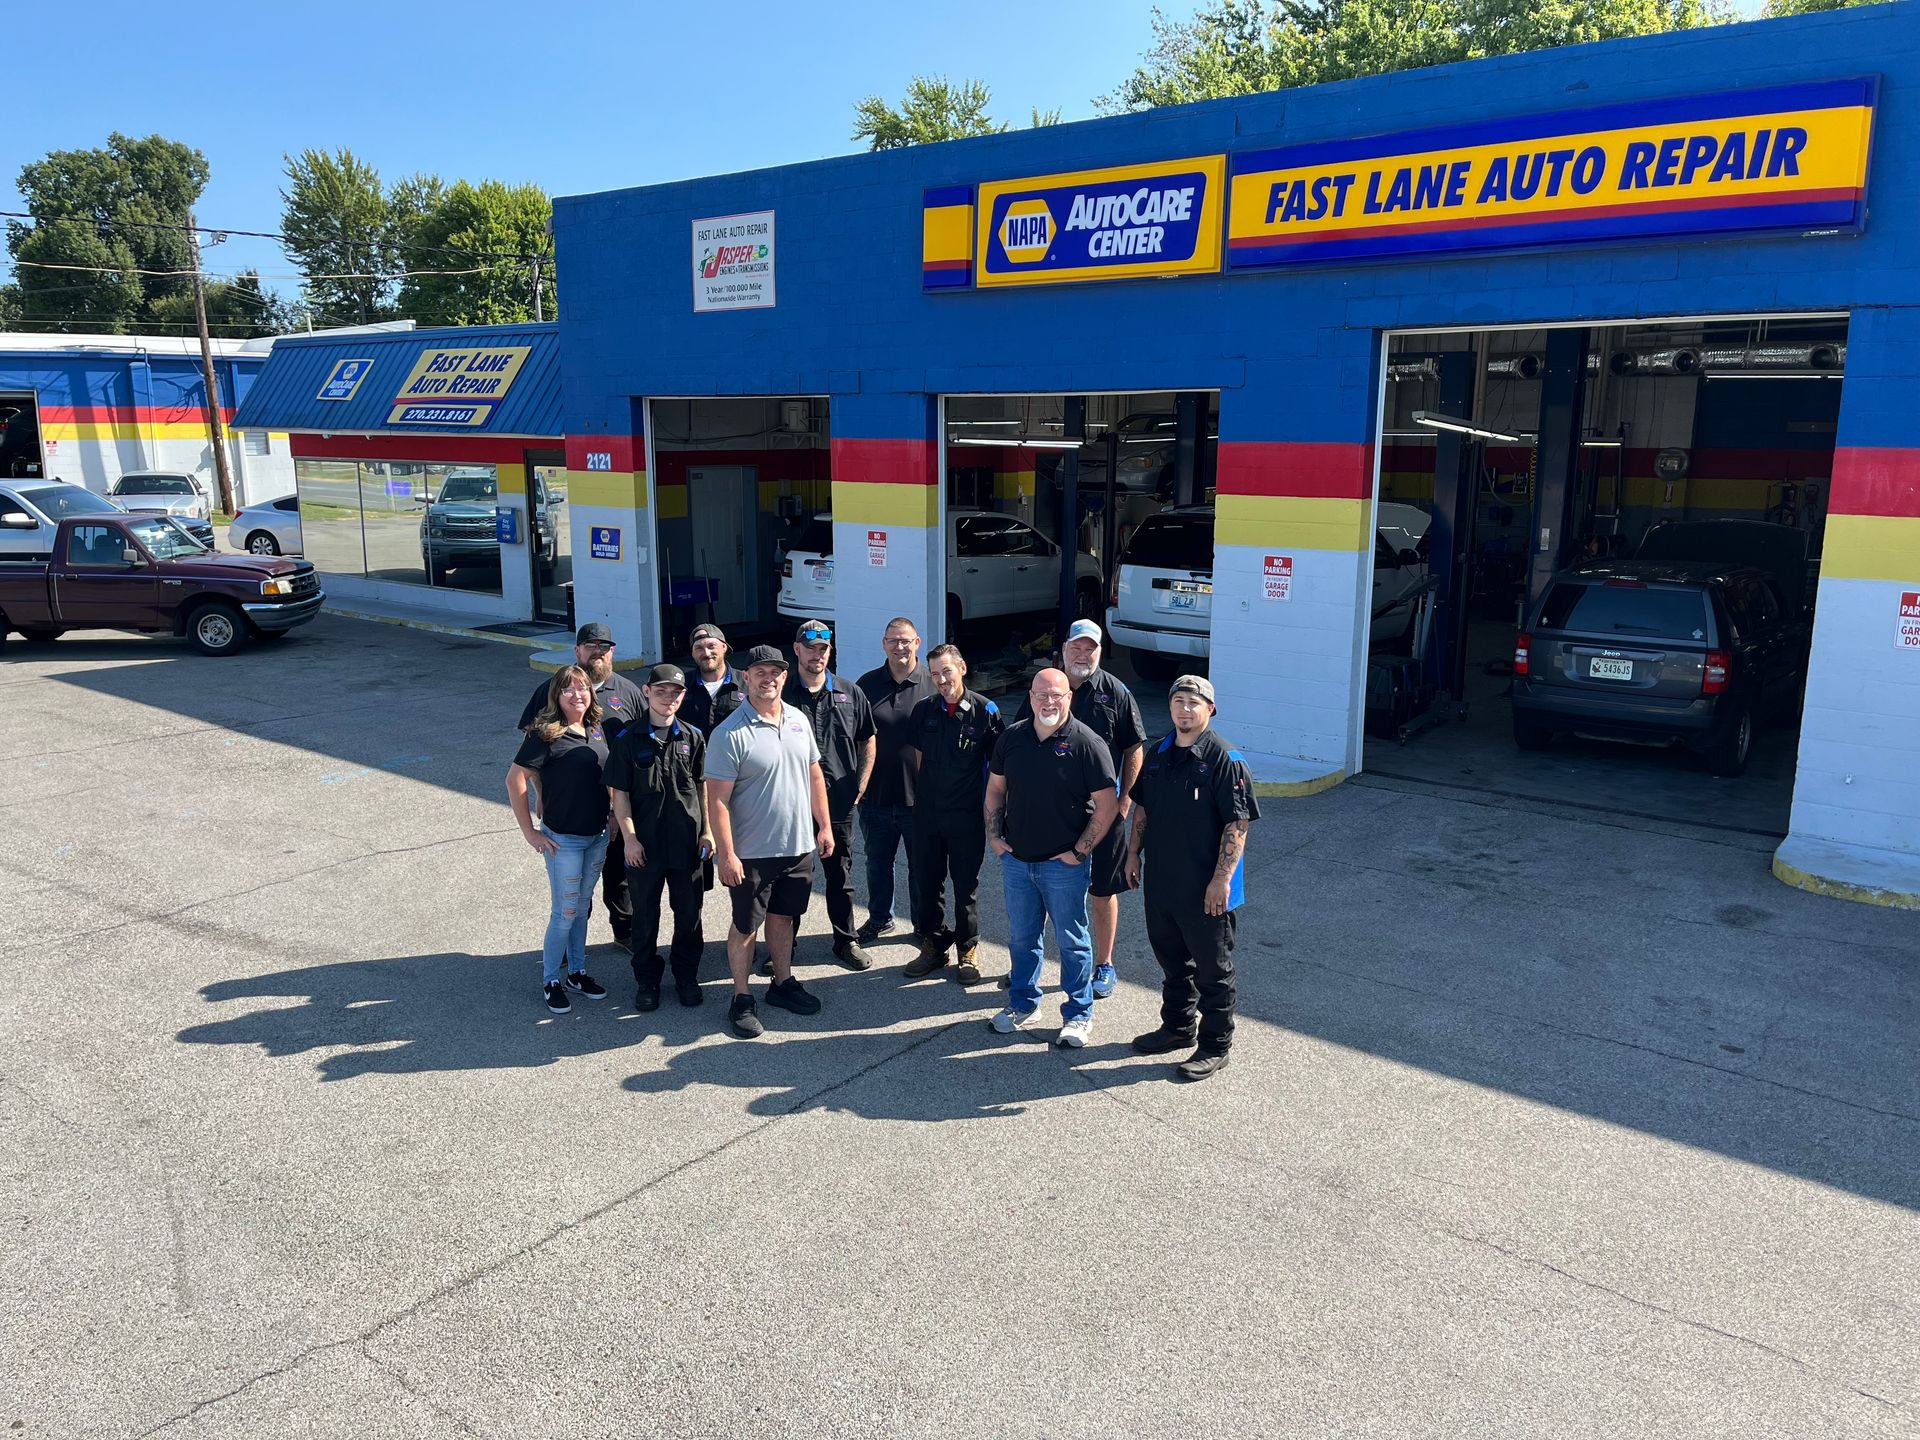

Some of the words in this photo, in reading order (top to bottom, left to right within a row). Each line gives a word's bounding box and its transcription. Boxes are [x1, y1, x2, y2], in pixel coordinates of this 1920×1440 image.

[1264, 174, 1356, 224] FAST
[1362, 161, 1472, 215] LANE
[1476, 146, 1607, 204] AUTO
[1618, 127, 1807, 190] REPAIR
[698, 230, 711, 241] FAST
[713, 228, 727, 240] LANE
[729, 226, 745, 237] AUTO
[747, 223, 768, 235] REPAIR
[1008, 216, 1047, 247] NAPA
[1088, 226, 1164, 258] CENTER
[704, 245, 753, 278] JASPER
[720, 265, 735, 275] ENGINES
[738, 262, 769, 274] TRANSMISSIONS
[706, 286, 710, 294] 3
[749, 283, 762, 291] Mile
[708, 295, 736, 303] Nationwide
[737, 293, 761, 302] Warranty
[425, 353, 468, 372] FAST
[464, 352, 514, 372] LANE
[407, 375, 448, 393] AUTO
[446, 374, 502, 393] REPAIR
[405, 409, 473, 420] 270.231.8161
[587, 453, 611, 469] 2121
[593, 543, 619, 553] BATTERIES
[1273, 558, 1283, 567] NO
[1264, 566, 1291, 576] PARKING
[1265, 582, 1289, 590] GARAGE
[1268, 590, 1285, 598] DOOR
[1604, 664, 1631, 675] 5436JS
